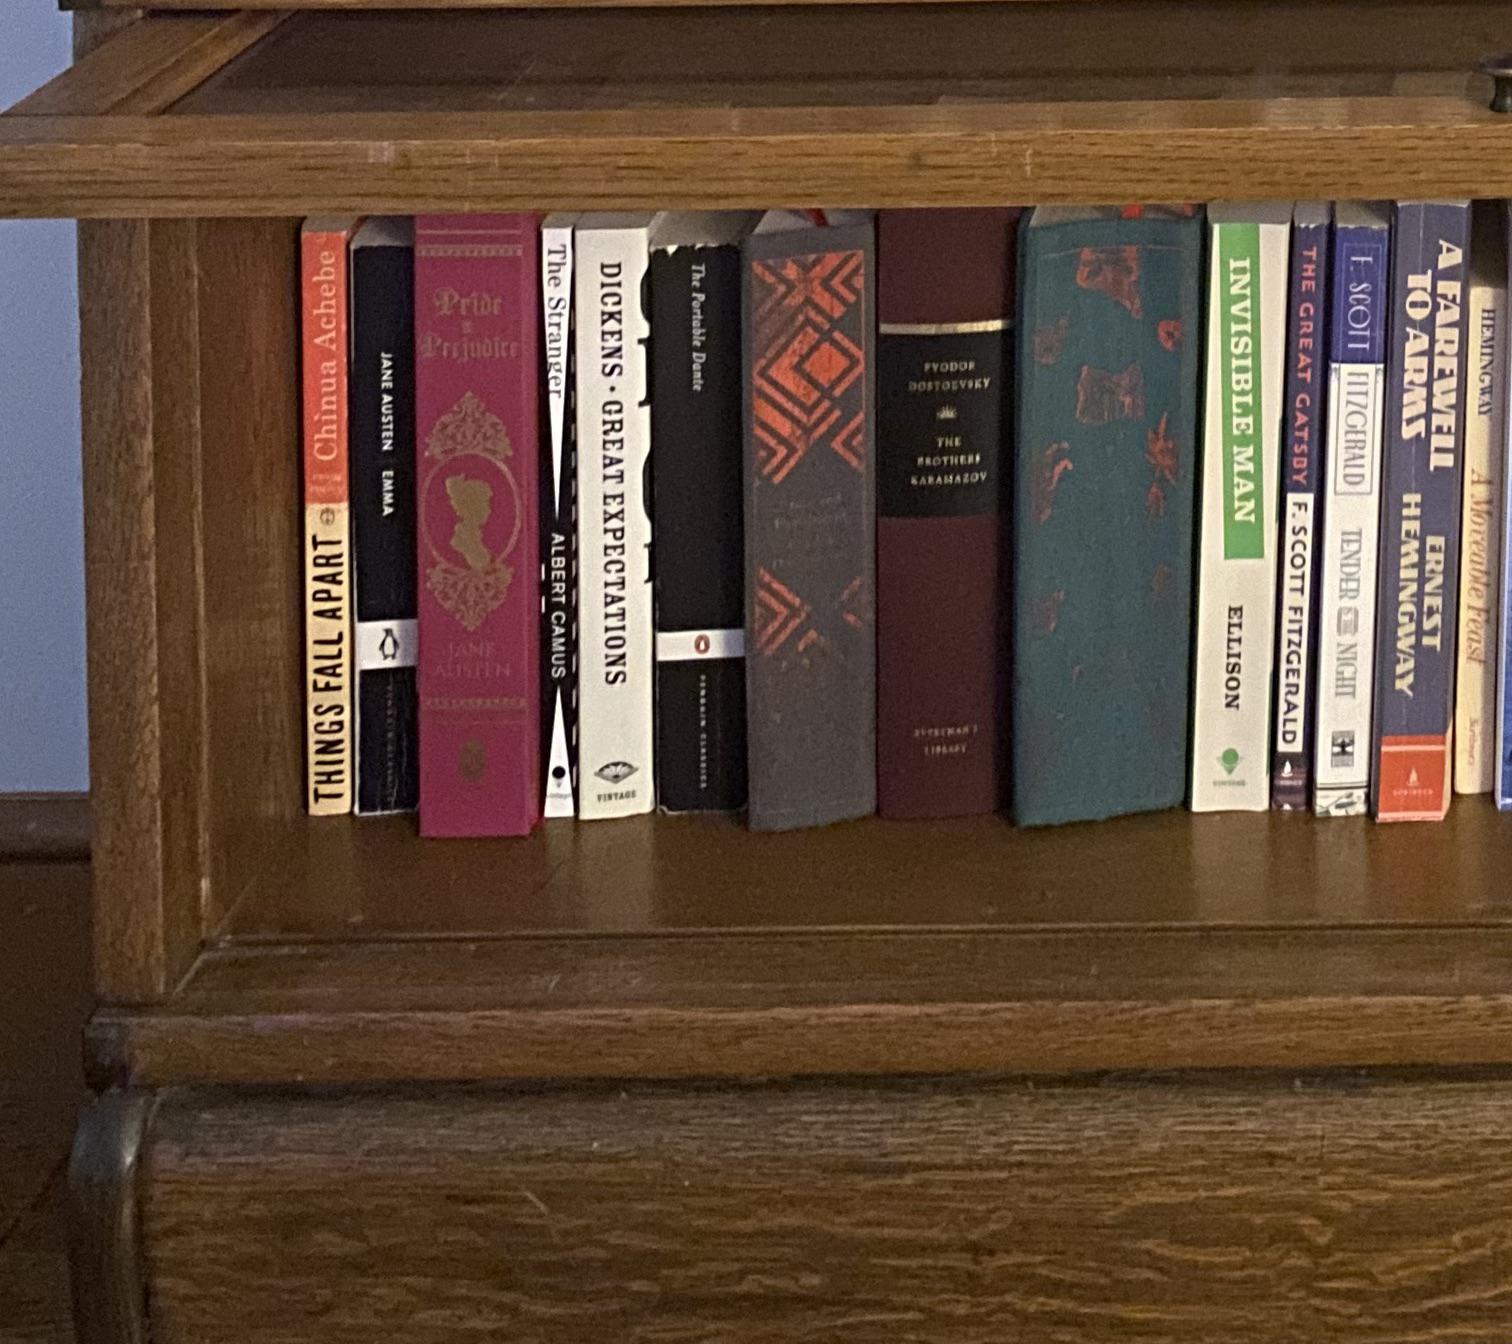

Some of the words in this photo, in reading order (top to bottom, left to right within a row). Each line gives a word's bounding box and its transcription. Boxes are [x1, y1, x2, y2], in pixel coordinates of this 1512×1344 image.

[312, 250, 338, 351] Achebe
[547, 243, 567, 289] The
[1301, 245, 1318, 293] THE
[548, 295, 568, 400] Stranger
[600, 261, 624, 378] DICKENS
[1229, 257, 1254, 437] INVISIBLE
[1297, 302, 1315, 385] GREAT
[312, 363, 339, 462] Chinua
[380, 352, 393, 390] JANE
[381, 392, 394, 452] AUSTEN
[601, 399, 625, 485] GREAT
[1291, 392, 1312, 487] GATSBY
[382, 470, 394, 517] EMMA
[1233, 445, 1256, 525] MAN
[311, 533, 344, 621] APART
[551, 533, 565, 607] ALBERT
[603, 494, 628, 687] EXPECTATIONS
[1394, 493, 1422, 699] HEMINGWAY
[1422, 535, 1446, 653] ERNEST
[312, 630, 344, 694] FALL
[551, 611, 566, 680] CAMUS
[1224, 605, 1244, 712] ELLISON
[312, 702, 345, 805] THINGS
